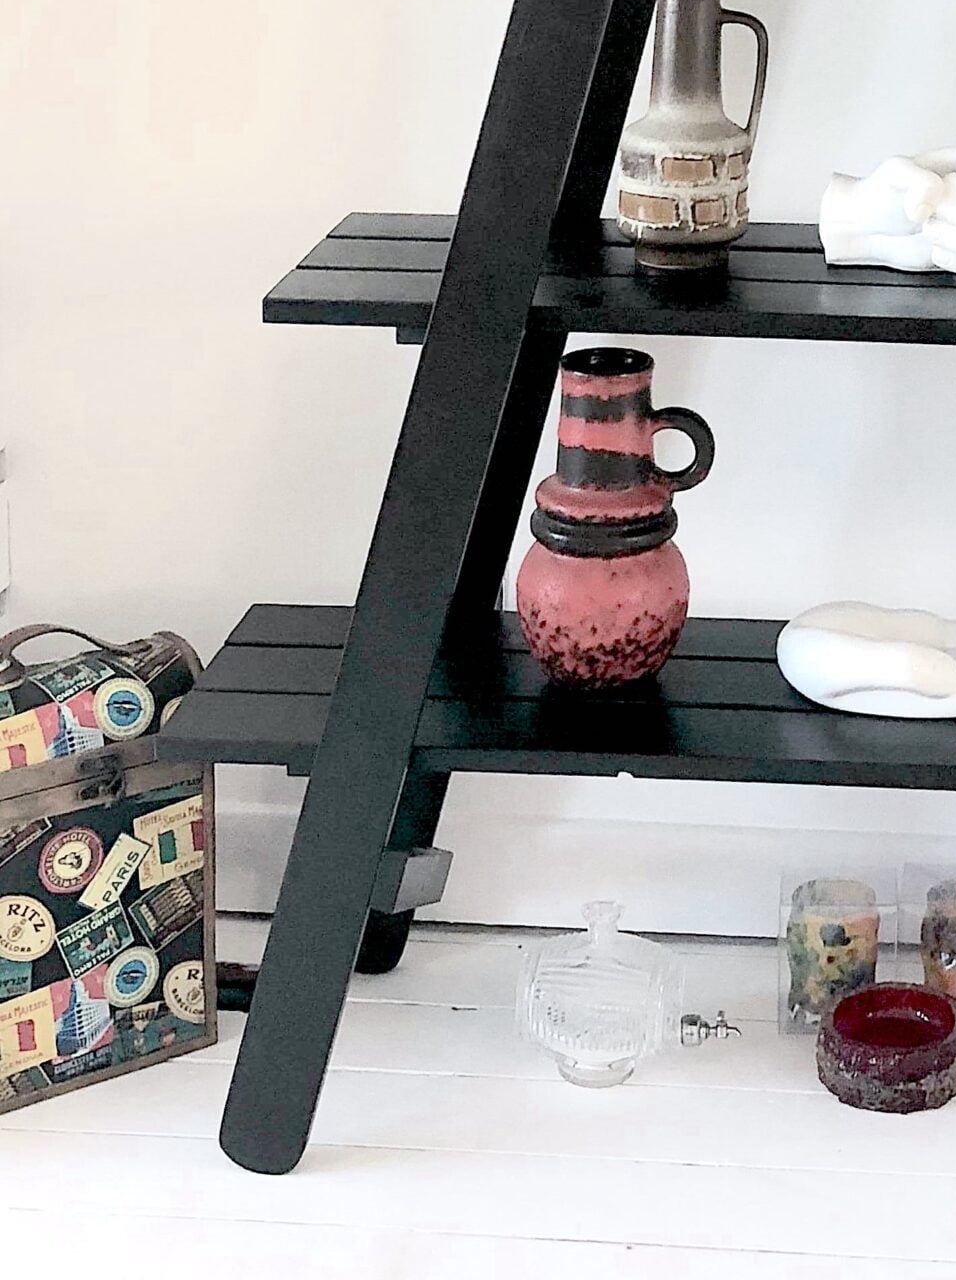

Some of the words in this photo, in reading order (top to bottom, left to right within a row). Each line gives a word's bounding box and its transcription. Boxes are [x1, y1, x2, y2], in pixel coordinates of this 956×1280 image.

[102, 851, 139, 903] PARIS
[7, 903, 46, 933] RITZ
[91, 906, 121, 930] GRAND
[60, 924, 91, 948] HOTEL
[73, 949, 111, 977] PALERMO
